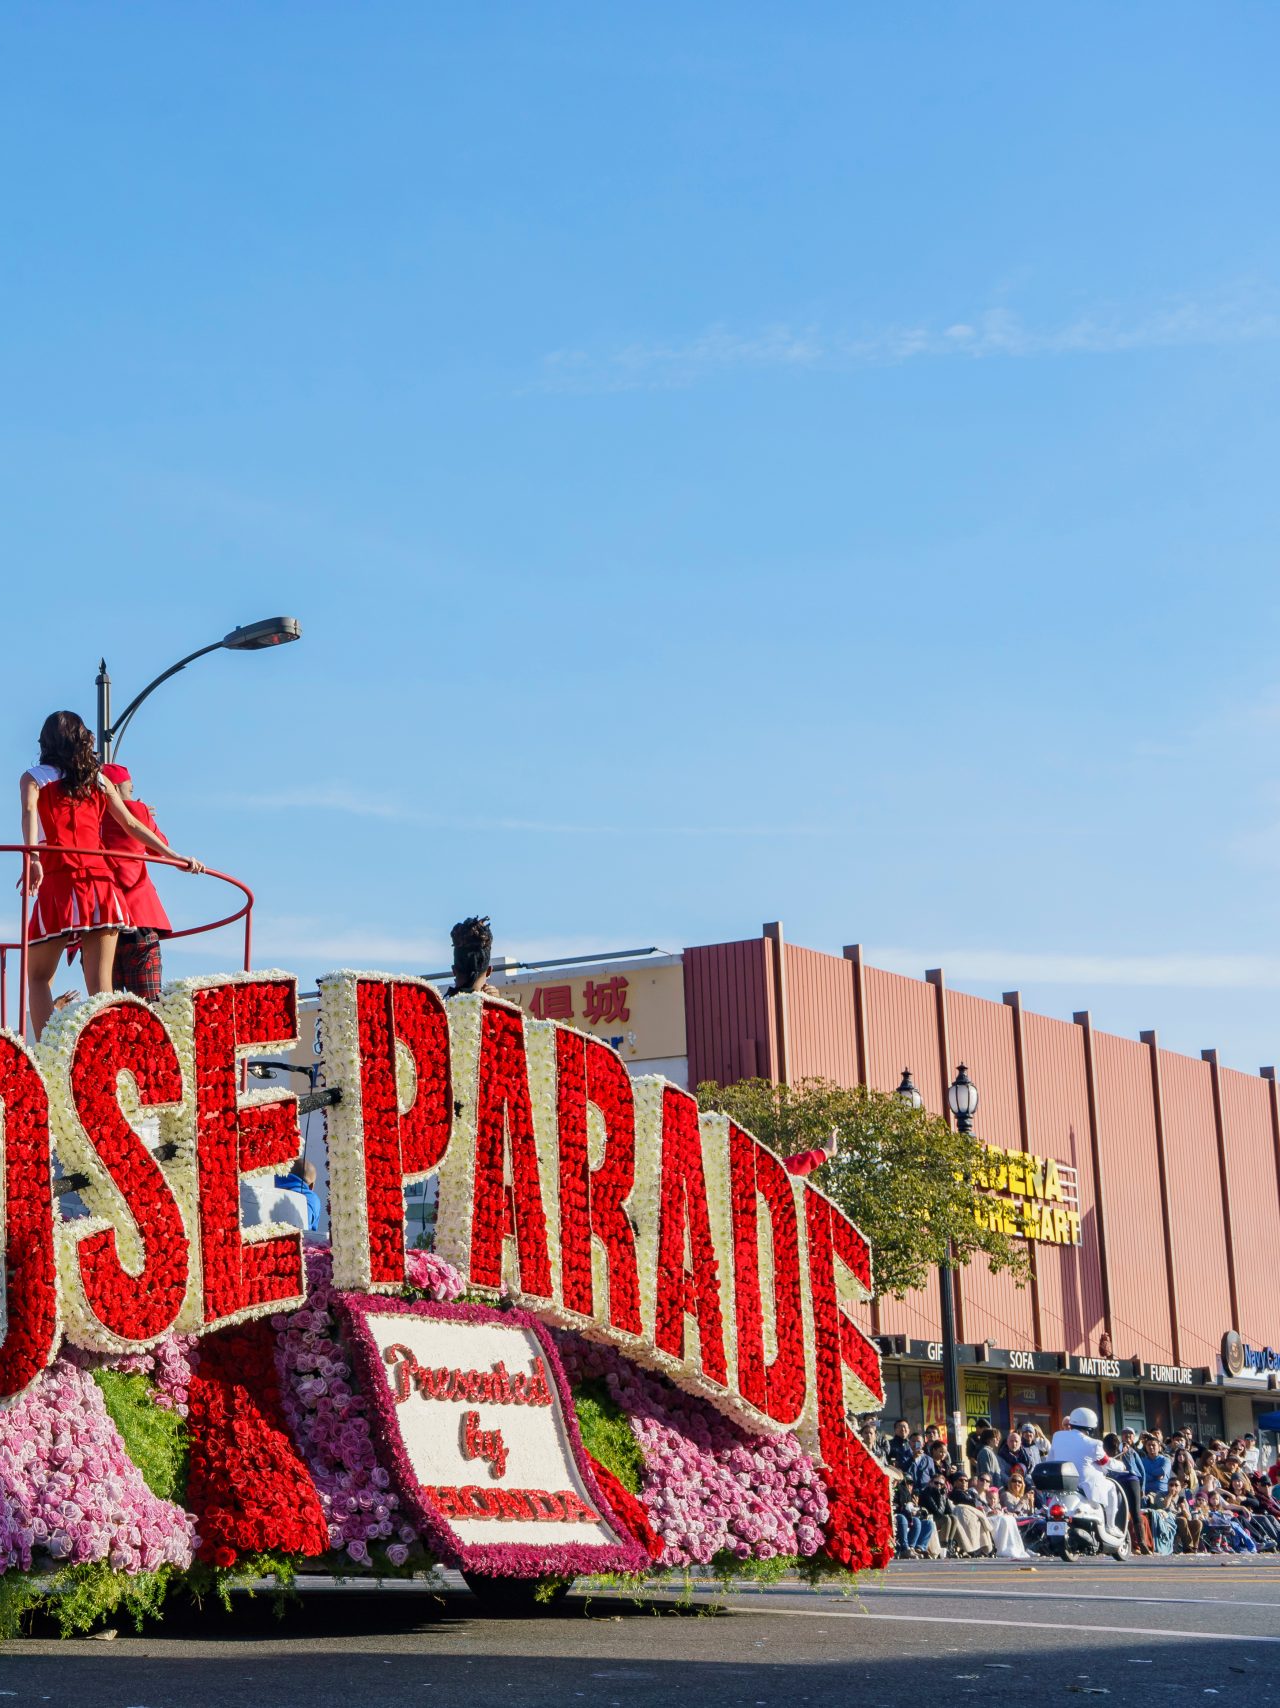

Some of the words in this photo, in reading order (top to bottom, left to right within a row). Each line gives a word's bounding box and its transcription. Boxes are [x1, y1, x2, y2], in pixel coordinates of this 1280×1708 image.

[1022, 1200, 1081, 1245] MART
[318, 967, 894, 1572] PARADE
[927, 1342, 943, 1361] GIF
[1009, 1350, 1035, 1370] SOFA
[1244, 1343, 1266, 1374] Navy
[1266, 1346, 1280, 1371] Ca
[384, 1343, 554, 1407] Presented
[1079, 1357, 1120, 1378] MATTRESS
[1150, 1364, 1193, 1385] FURNITURE
[924, 1388, 945, 1425] 70
[966, 1394, 989, 1415] MUST
[1181, 1401, 1196, 1416] TAKE
[1199, 1403, 1208, 1417] HE
[461, 1410, 509, 1479] by
[421, 1485, 603, 1523] HONDA
